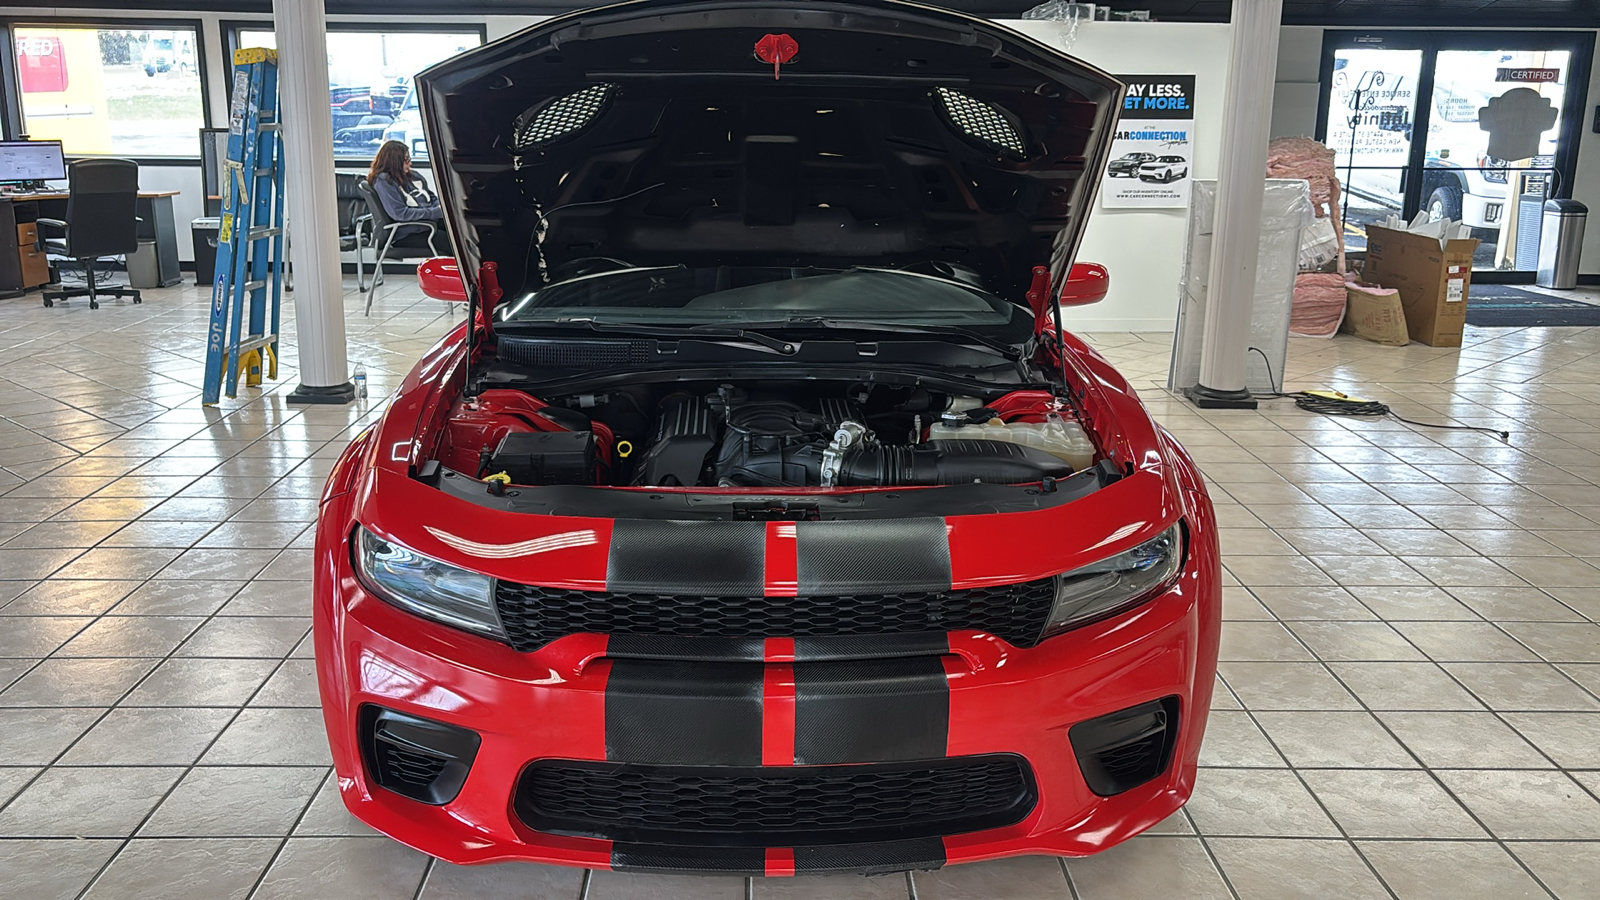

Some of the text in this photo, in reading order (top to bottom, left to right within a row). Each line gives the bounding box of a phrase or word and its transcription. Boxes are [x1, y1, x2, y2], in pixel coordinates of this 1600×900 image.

[1510, 70, 1554, 80] CERTIFIED
[1125, 84, 1185, 97] AY LESS.
[1124, 97, 1190, 109] ET MORE.
[211, 322, 222, 353] JOE
